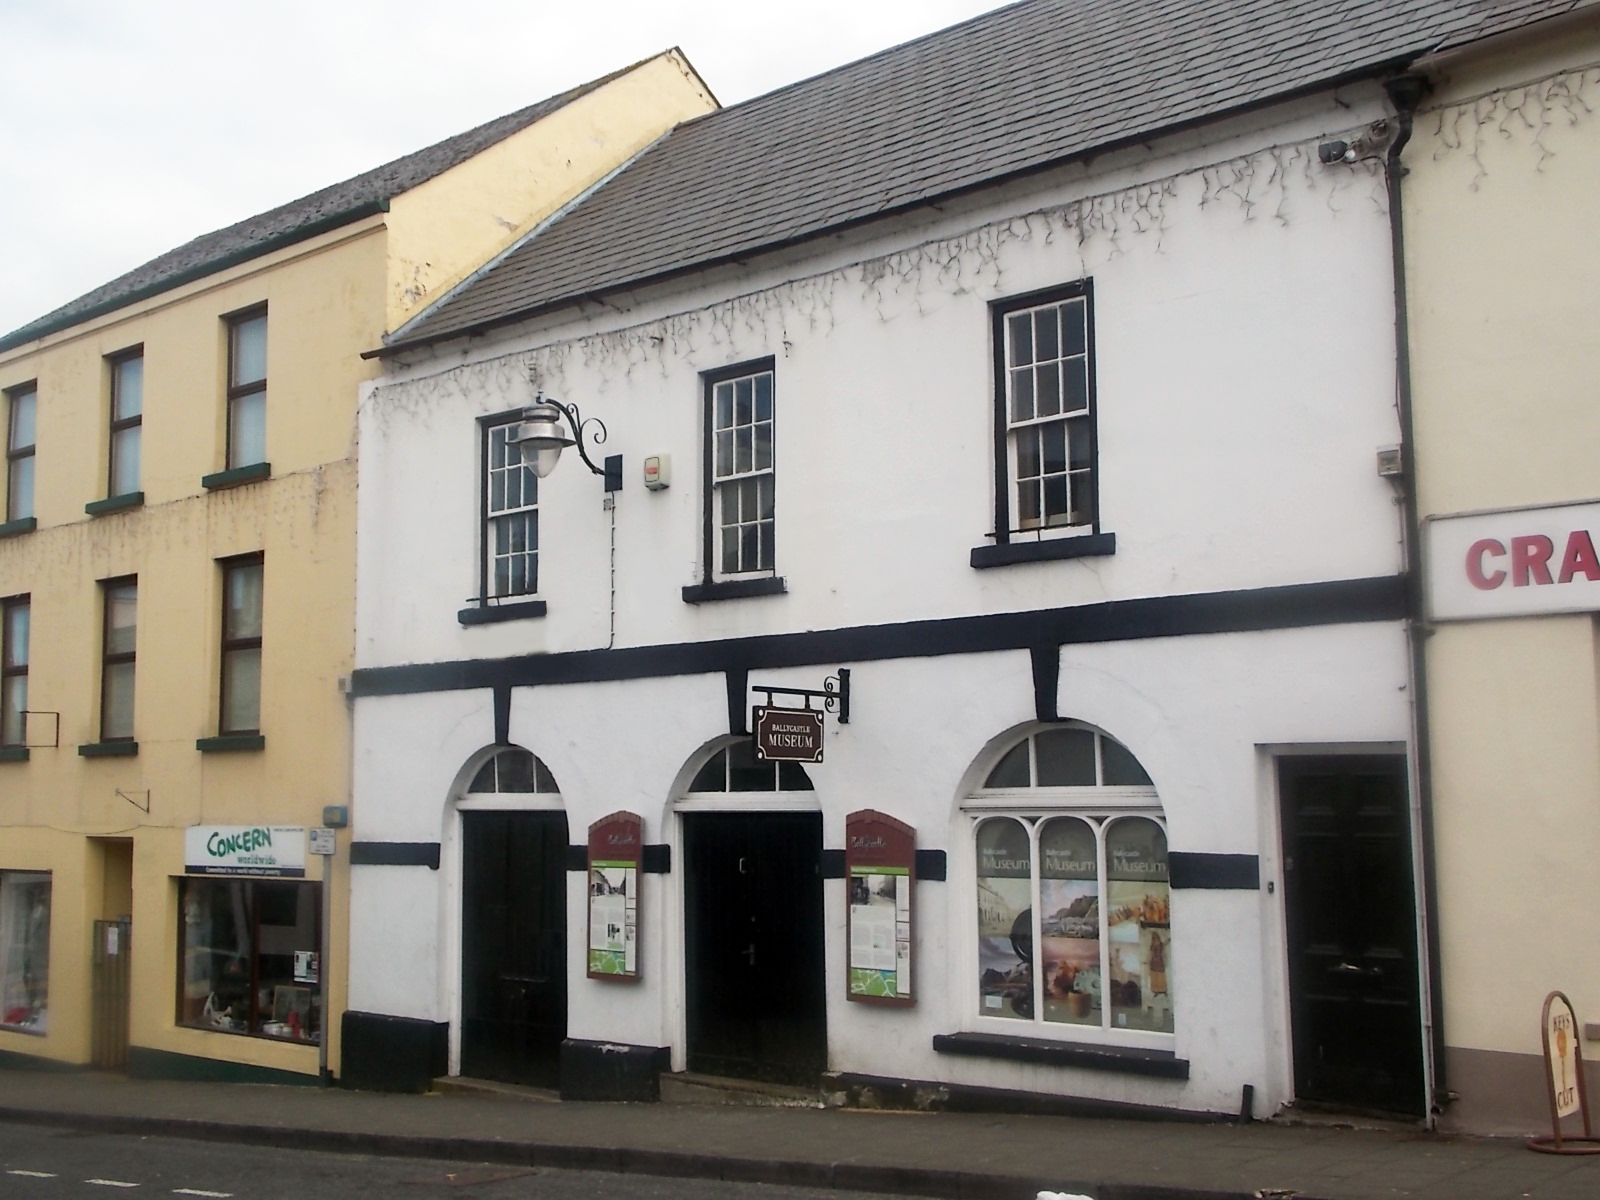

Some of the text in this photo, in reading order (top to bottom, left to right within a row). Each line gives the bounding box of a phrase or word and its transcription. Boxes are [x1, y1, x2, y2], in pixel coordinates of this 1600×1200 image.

[1465, 530, 1600, 591] CRA
[772, 723, 811, 733] BALLYCASTLE
[769, 733, 813, 748] MUSEUM
[207, 827, 272, 857] CONCERN
[237, 854, 276, 865] worldwide
[983, 856, 1030, 870] Museum
[1046, 857, 1096, 872] Museum
[1113, 858, 1166, 873] Museum
[1553, 1013, 1571, 1032] KEYS
[1558, 1086, 1574, 1111] CUT
